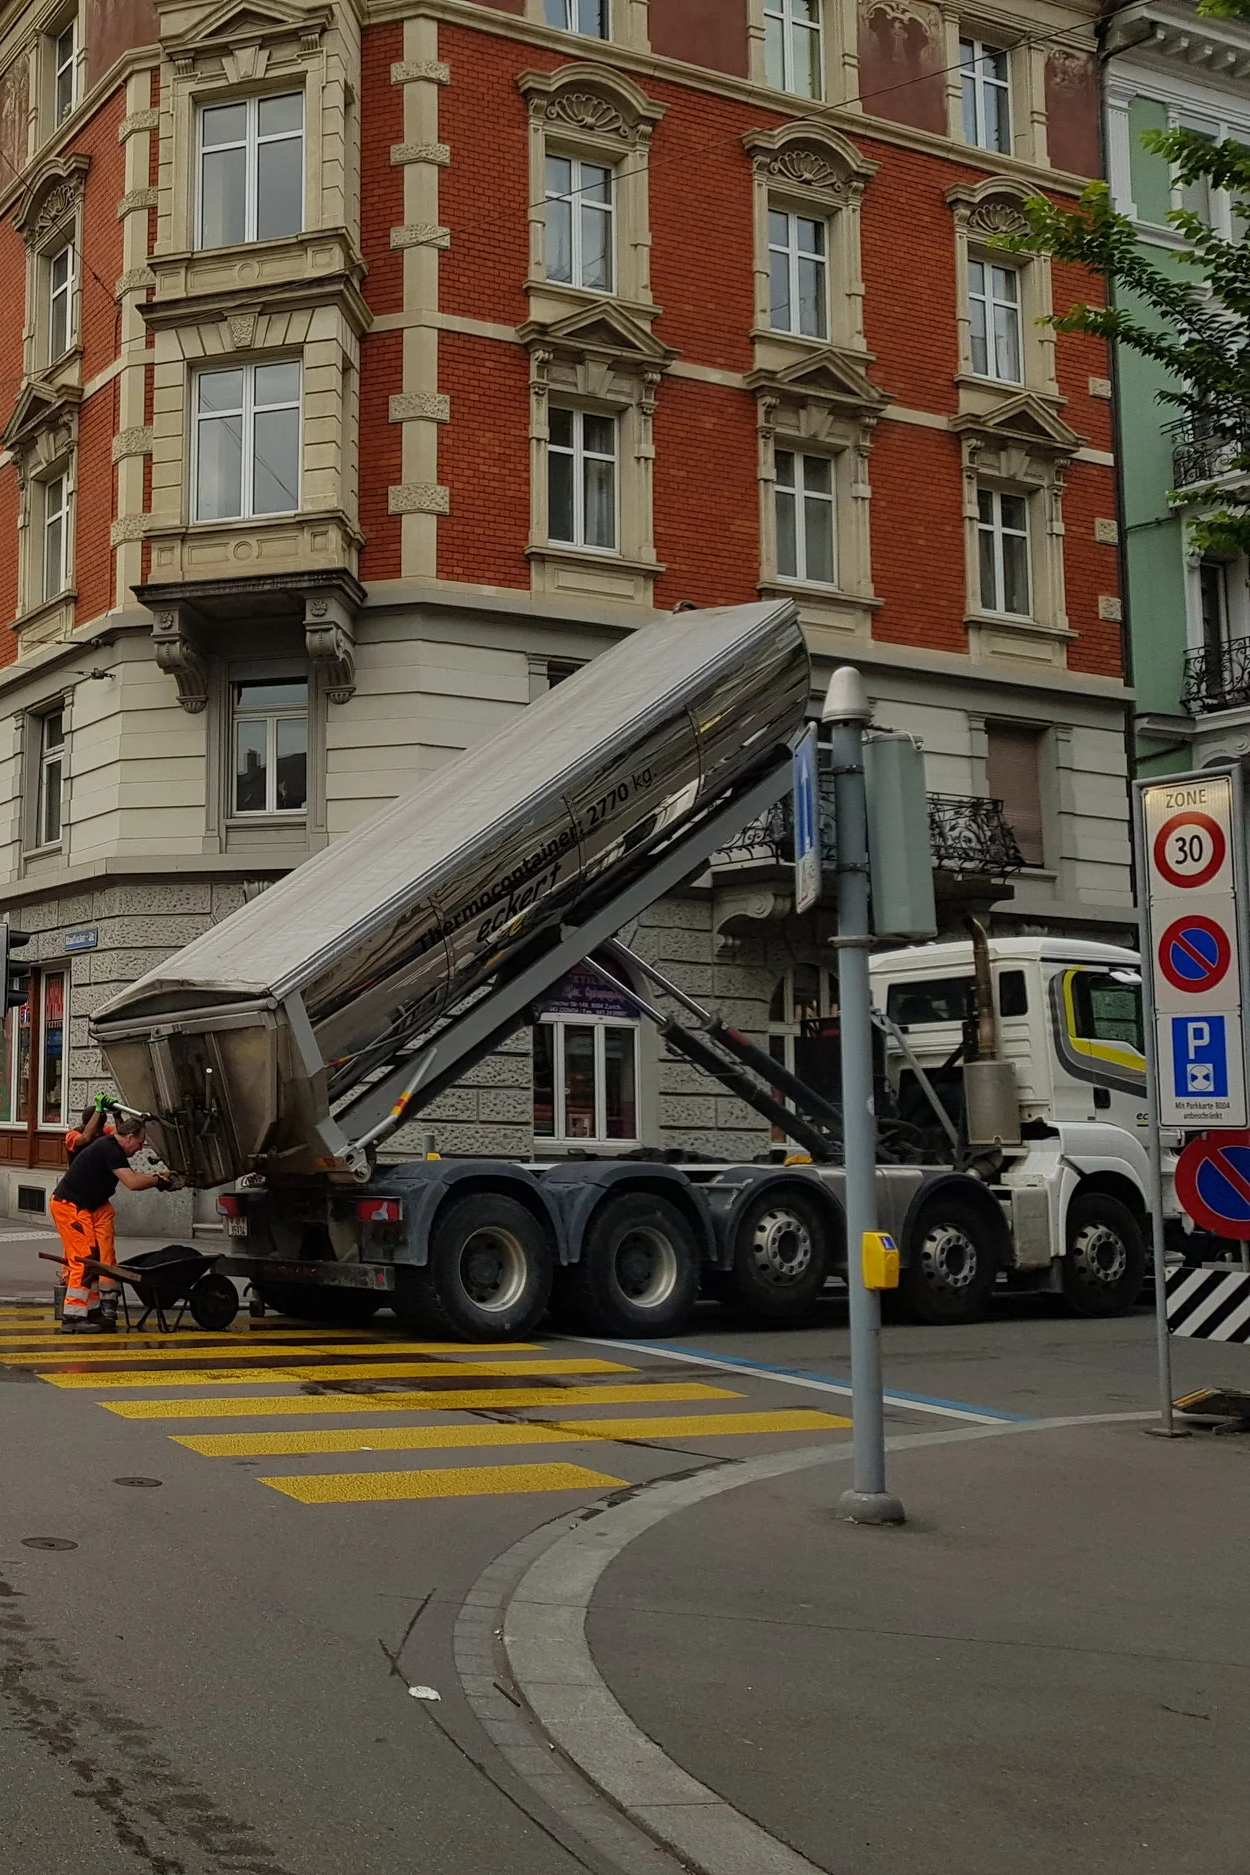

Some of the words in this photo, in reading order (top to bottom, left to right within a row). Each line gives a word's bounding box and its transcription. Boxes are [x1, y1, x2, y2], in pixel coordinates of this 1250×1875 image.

[587, 783, 629, 826] 2770
[631, 767, 658, 792] kg.
[1166, 789, 1206, 808] ZONE
[1175, 834, 1203, 864] 30
[476, 863, 562, 943] eckert
[1187, 1021, 1210, 1060] P
